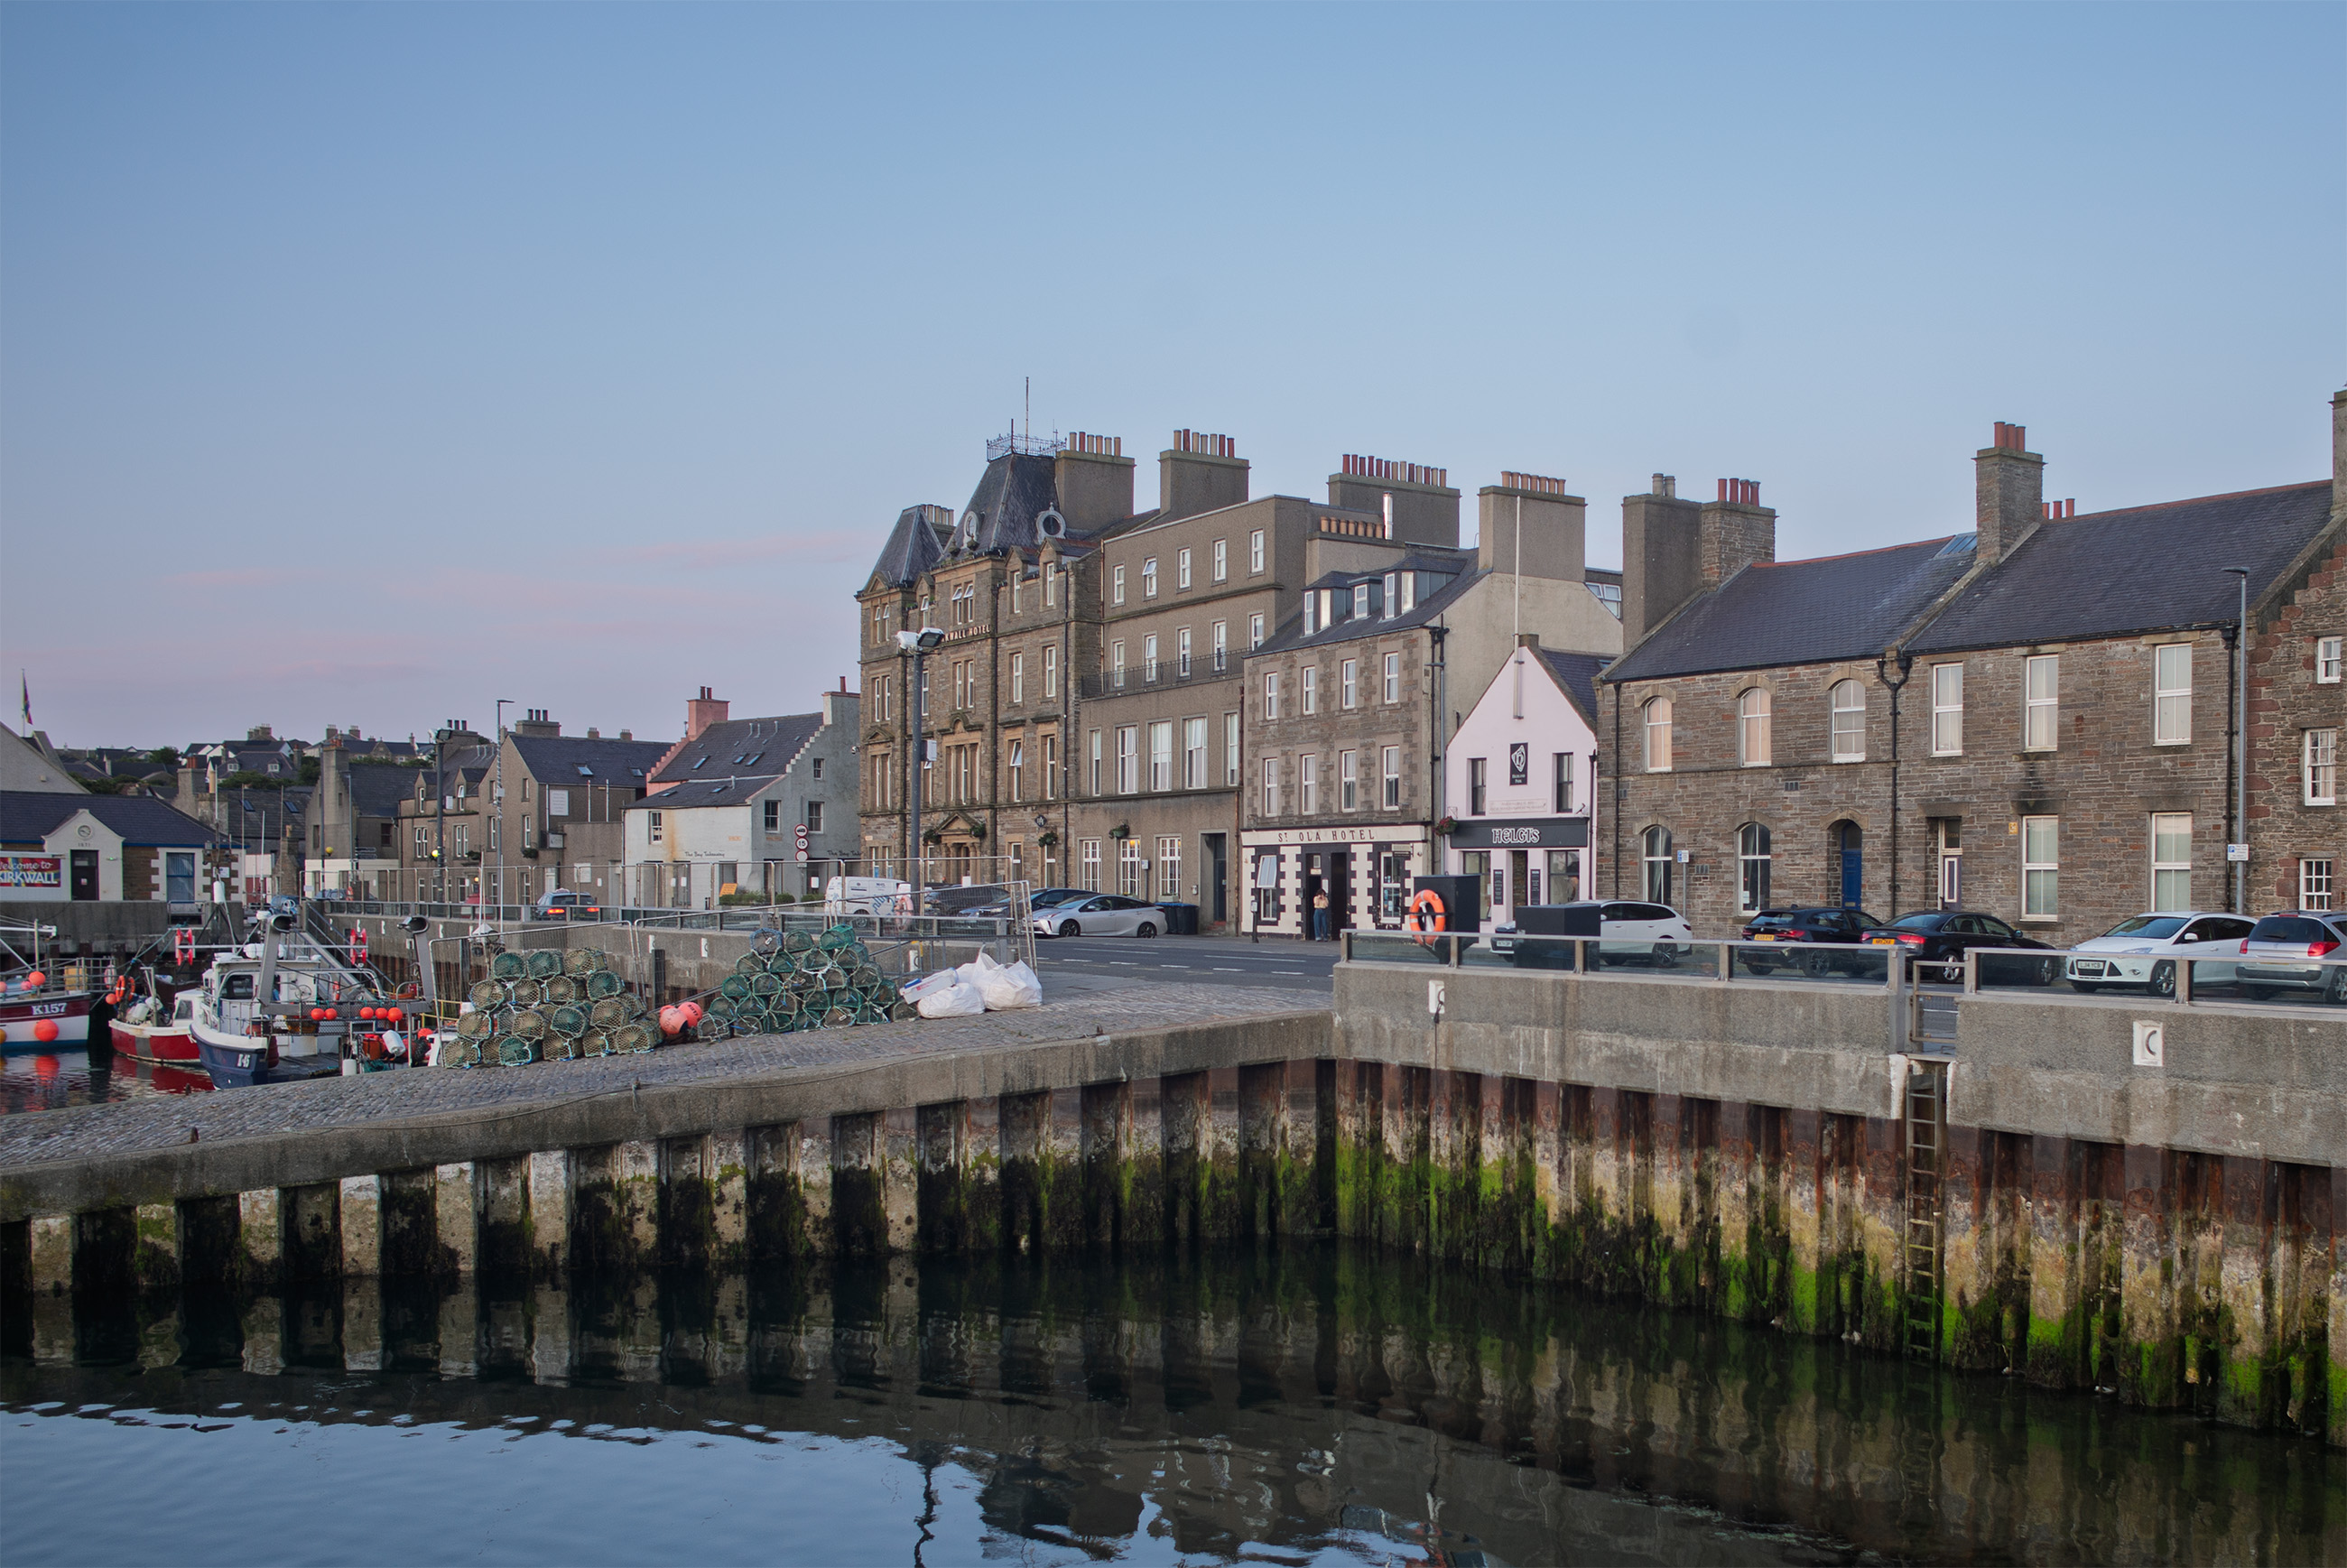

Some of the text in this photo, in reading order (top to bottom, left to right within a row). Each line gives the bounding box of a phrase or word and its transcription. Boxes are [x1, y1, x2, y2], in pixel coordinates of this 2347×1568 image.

[969, 624, 990, 636] HOTEL
[1299, 831, 1322, 841] OLA
[1331, 829, 1375, 840] HOTEL
[0, 861, 52, 870] elcome to
[31, 1002, 68, 1016] K157
